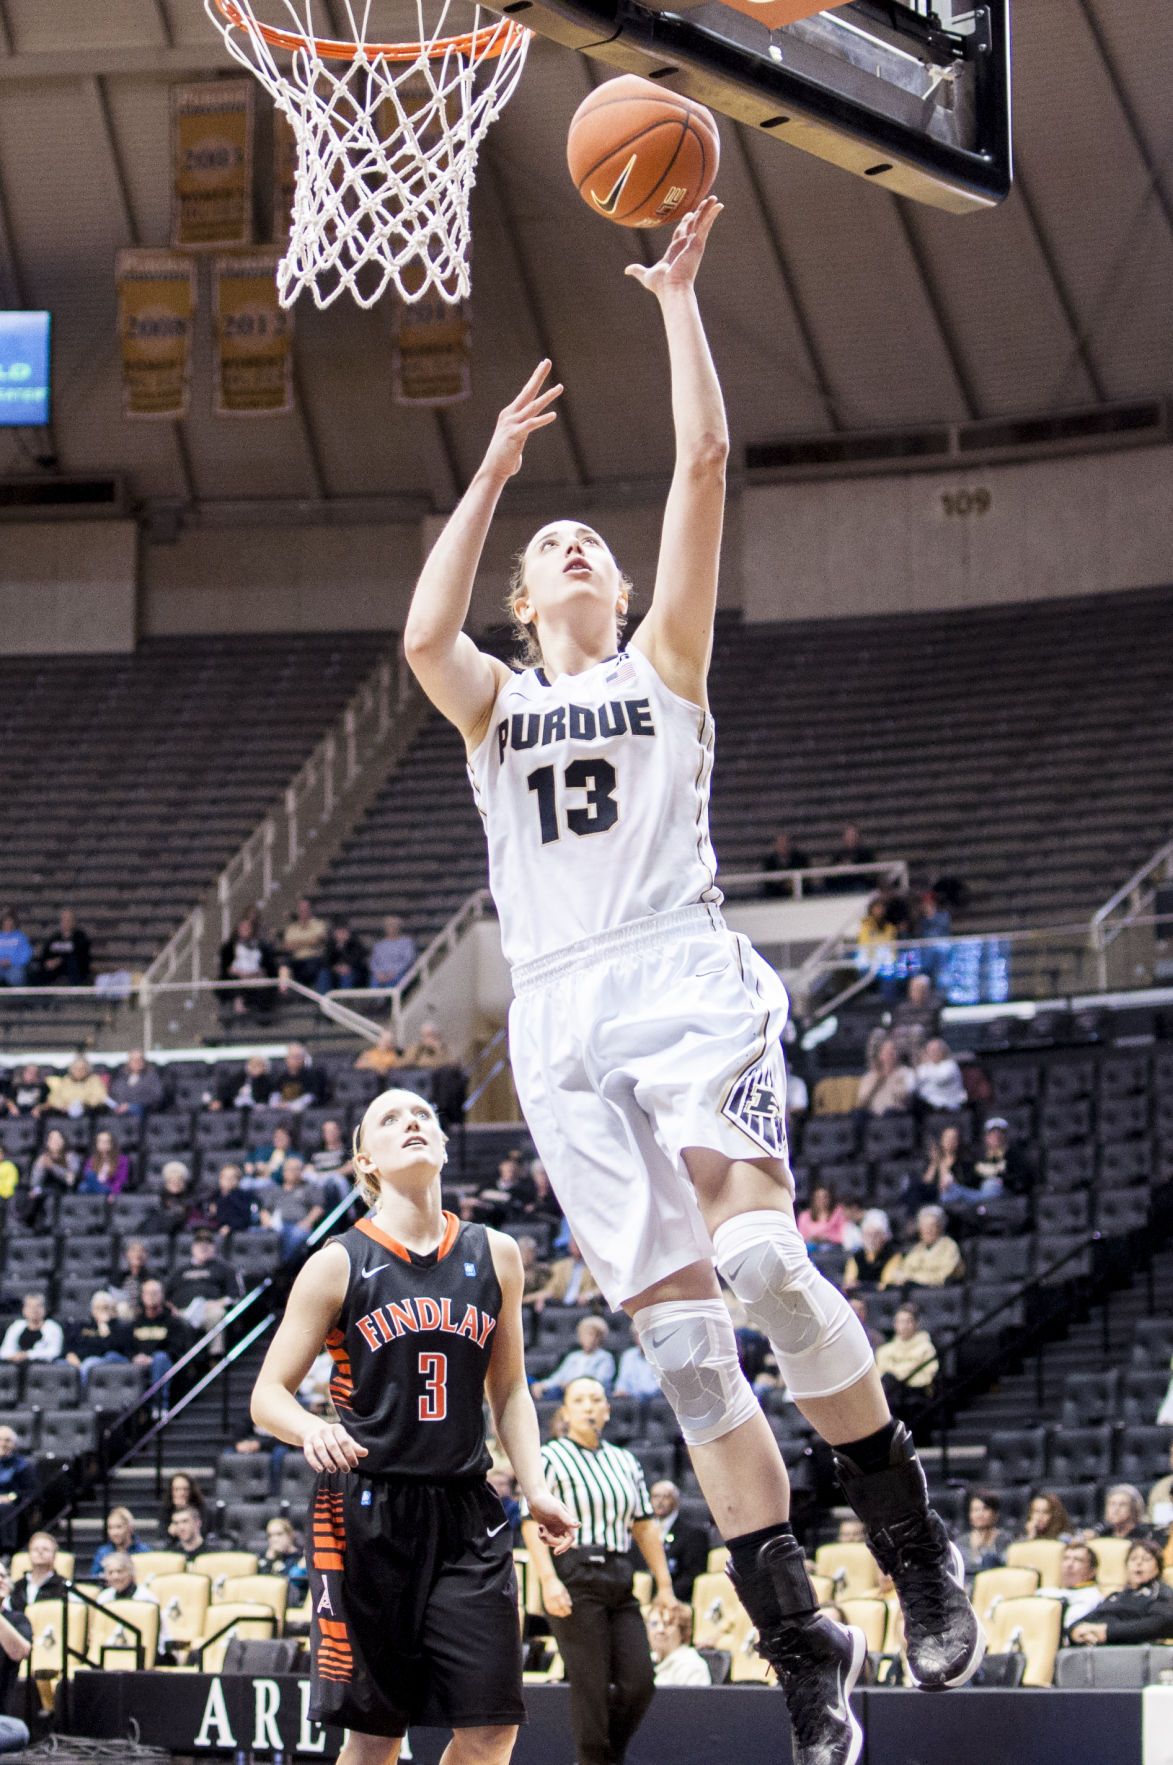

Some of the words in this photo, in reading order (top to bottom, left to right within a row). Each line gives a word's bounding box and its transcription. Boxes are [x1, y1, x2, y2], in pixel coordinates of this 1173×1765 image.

[497, 697, 656, 766] PURDUE
[527, 758, 619, 847] 13
[355, 1296, 497, 1352] FINDLAY
[418, 1351, 448, 1422] 3
